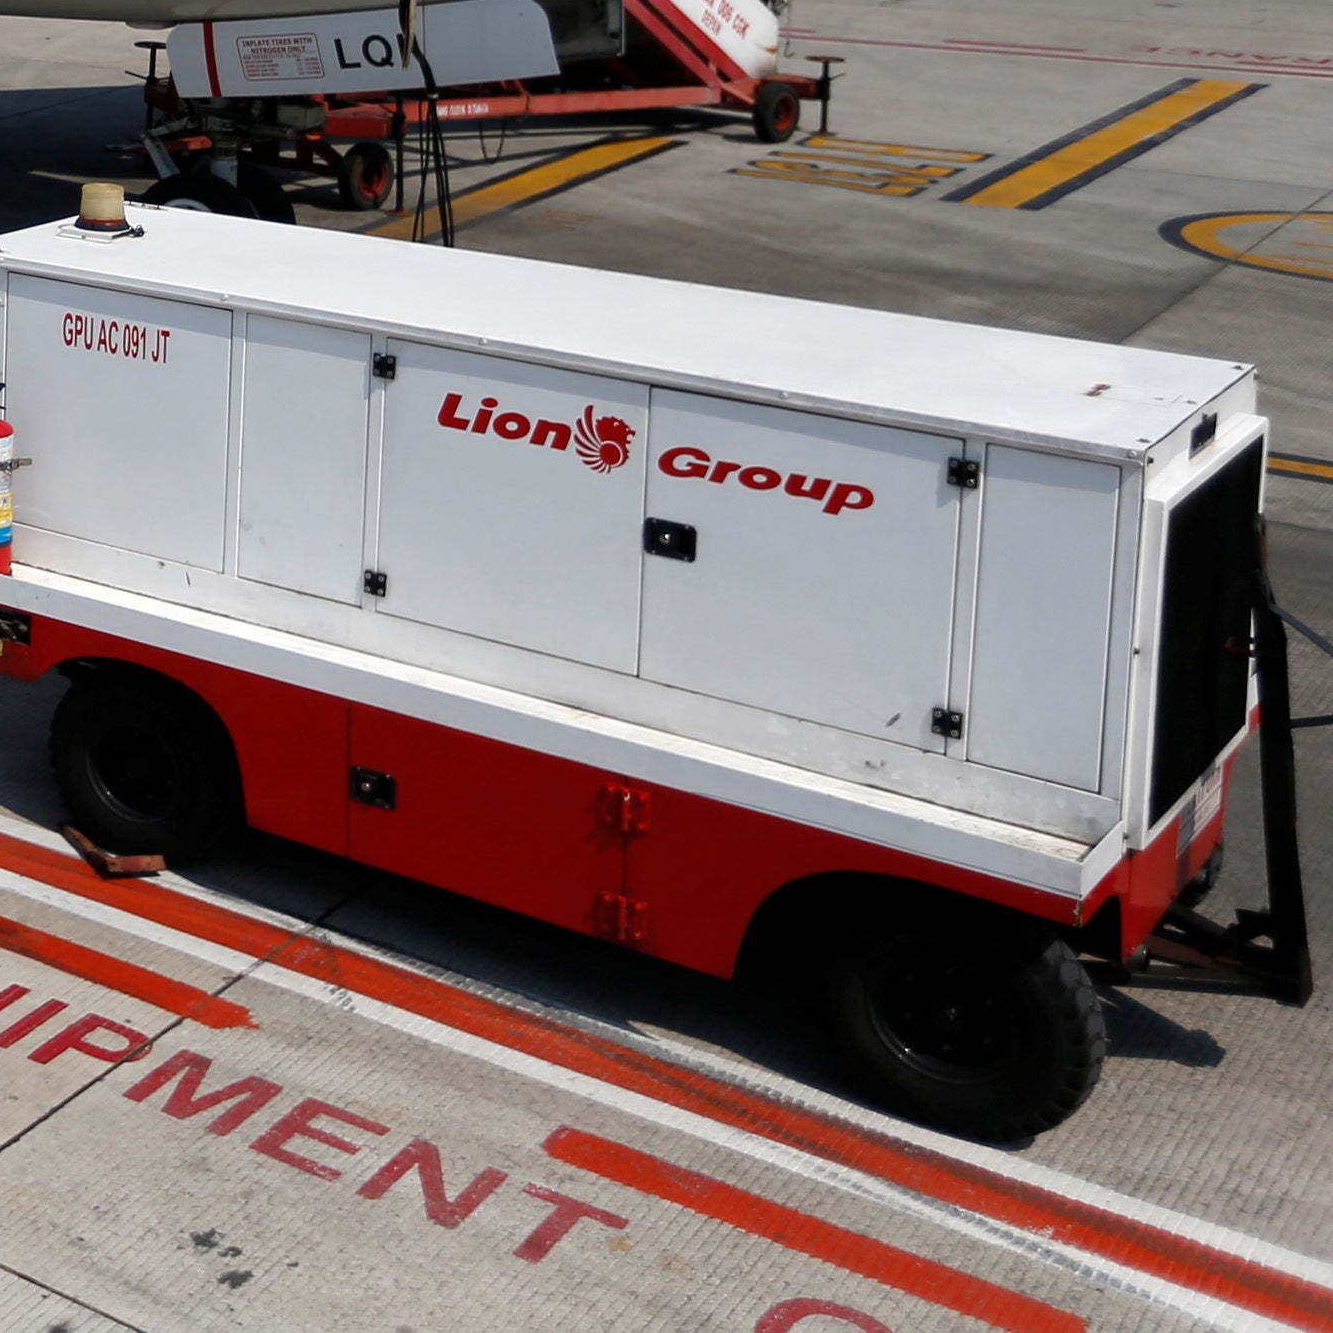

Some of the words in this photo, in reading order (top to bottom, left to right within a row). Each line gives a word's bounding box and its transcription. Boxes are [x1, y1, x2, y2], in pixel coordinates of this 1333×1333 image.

[242, 39, 270, 47] INFLATE
[272, 38, 291, 46] TIRES
[293, 37, 313, 45] WITH
[250, 46, 285, 54] NITROGEN
[287, 45, 306, 53] ONLY
[63, 313, 93, 350] GPU
[97, 319, 119, 354] AC
[123, 324, 146, 360] 091
[151, 329, 170, 364] JT
[437, 392, 572, 451] Lion
[657, 446, 875, 516] Group
